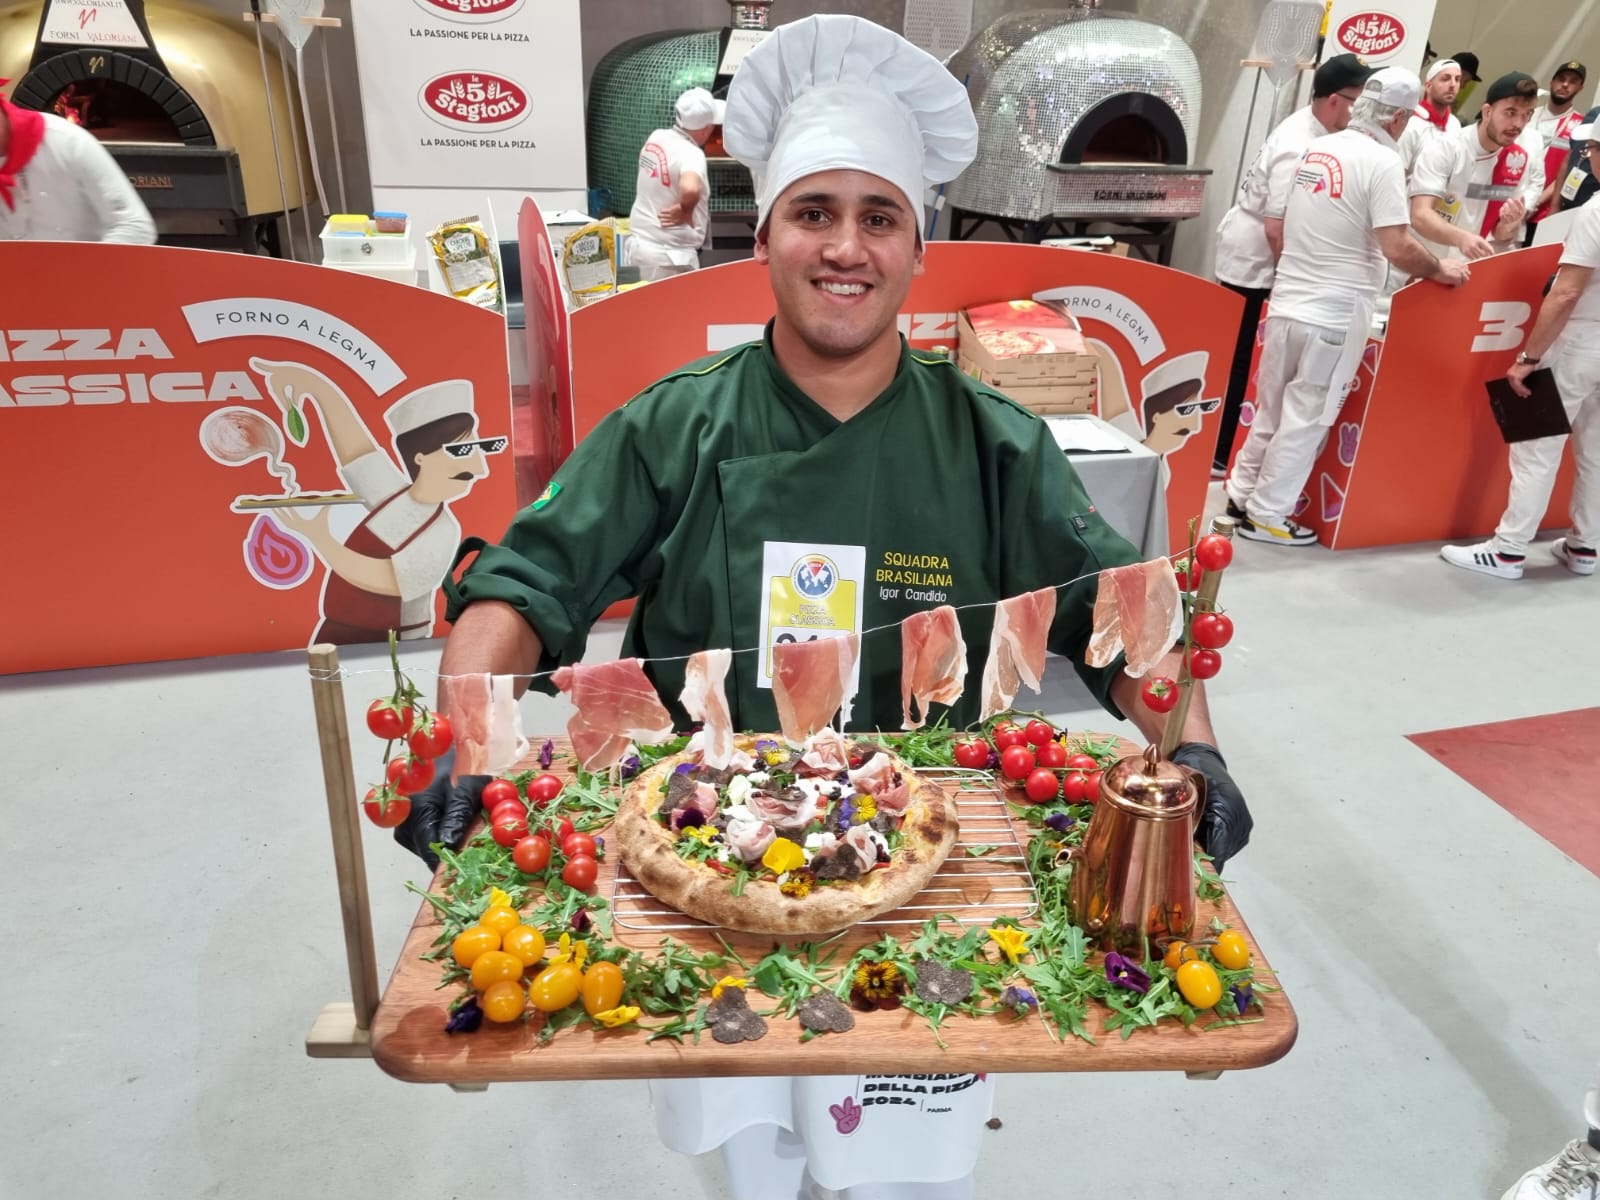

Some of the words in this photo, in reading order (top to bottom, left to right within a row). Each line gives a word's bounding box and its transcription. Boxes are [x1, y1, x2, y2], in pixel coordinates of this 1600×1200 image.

[410, 28, 422, 37] LA
[424, 29, 469, 40] PASSIONE
[471, 32, 488, 41] PER
[491, 33, 502, 41] LA
[504, 33, 530, 42] PIZZA
[1365, 21, 1379, 38] 5
[1342, 29, 1400, 54] Stagioni
[466, 83, 486, 102] 5
[435, 93, 521, 122] Stagioni
[420, 138, 432, 147] LA
[434, 138, 478, 148] PASSIONE
[480, 139, 497, 148] PER
[498, 140, 510, 149] LA
[512, 140, 536, 149] PIZZA
[128, 175, 172, 186] ORIANI
[1063, 297, 1101, 309] ORNO
[1104, 303, 1113, 313] A
[1116, 308, 1150, 344] LEGNA
[1470, 301, 1531, 352] 3
[215, 311, 290, 325] FORNO
[298, 319, 310, 331] A
[318, 325, 377, 371] LEGNA
[883, 552, 950, 569] SQUADRA
[876, 569, 953, 587] BRASILIANA
[879, 586, 899, 600] Igor
[905, 588, 947, 602] Candido
[864, 1083, 928, 1094] DELLA
[862, 1096, 916, 1107] 2024
